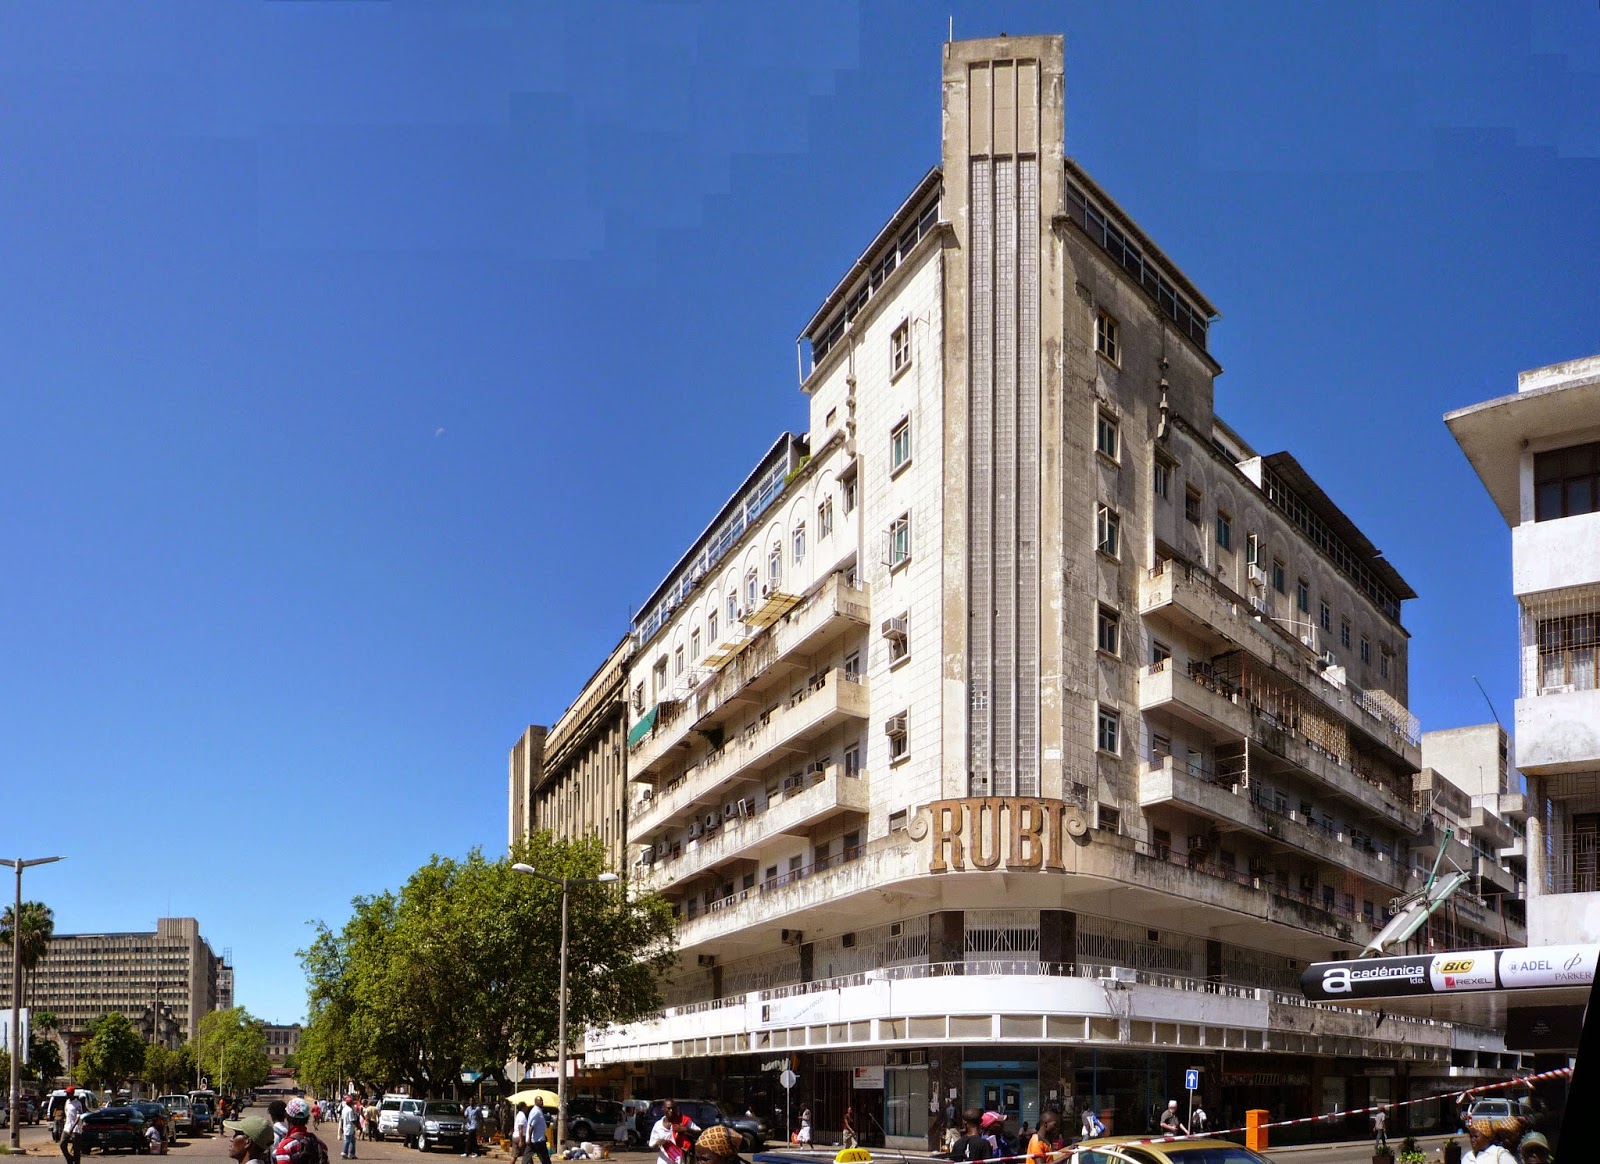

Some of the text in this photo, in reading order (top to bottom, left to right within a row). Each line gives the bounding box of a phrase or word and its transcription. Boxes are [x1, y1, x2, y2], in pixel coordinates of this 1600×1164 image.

[928, 797, 1064, 869] RUBI
[1520, 960, 1553, 971] ADEL
[1322, 965, 1425, 993] académica
[1455, 978, 1493, 986] REXEL
[1554, 972, 1592, 981] PARKER
